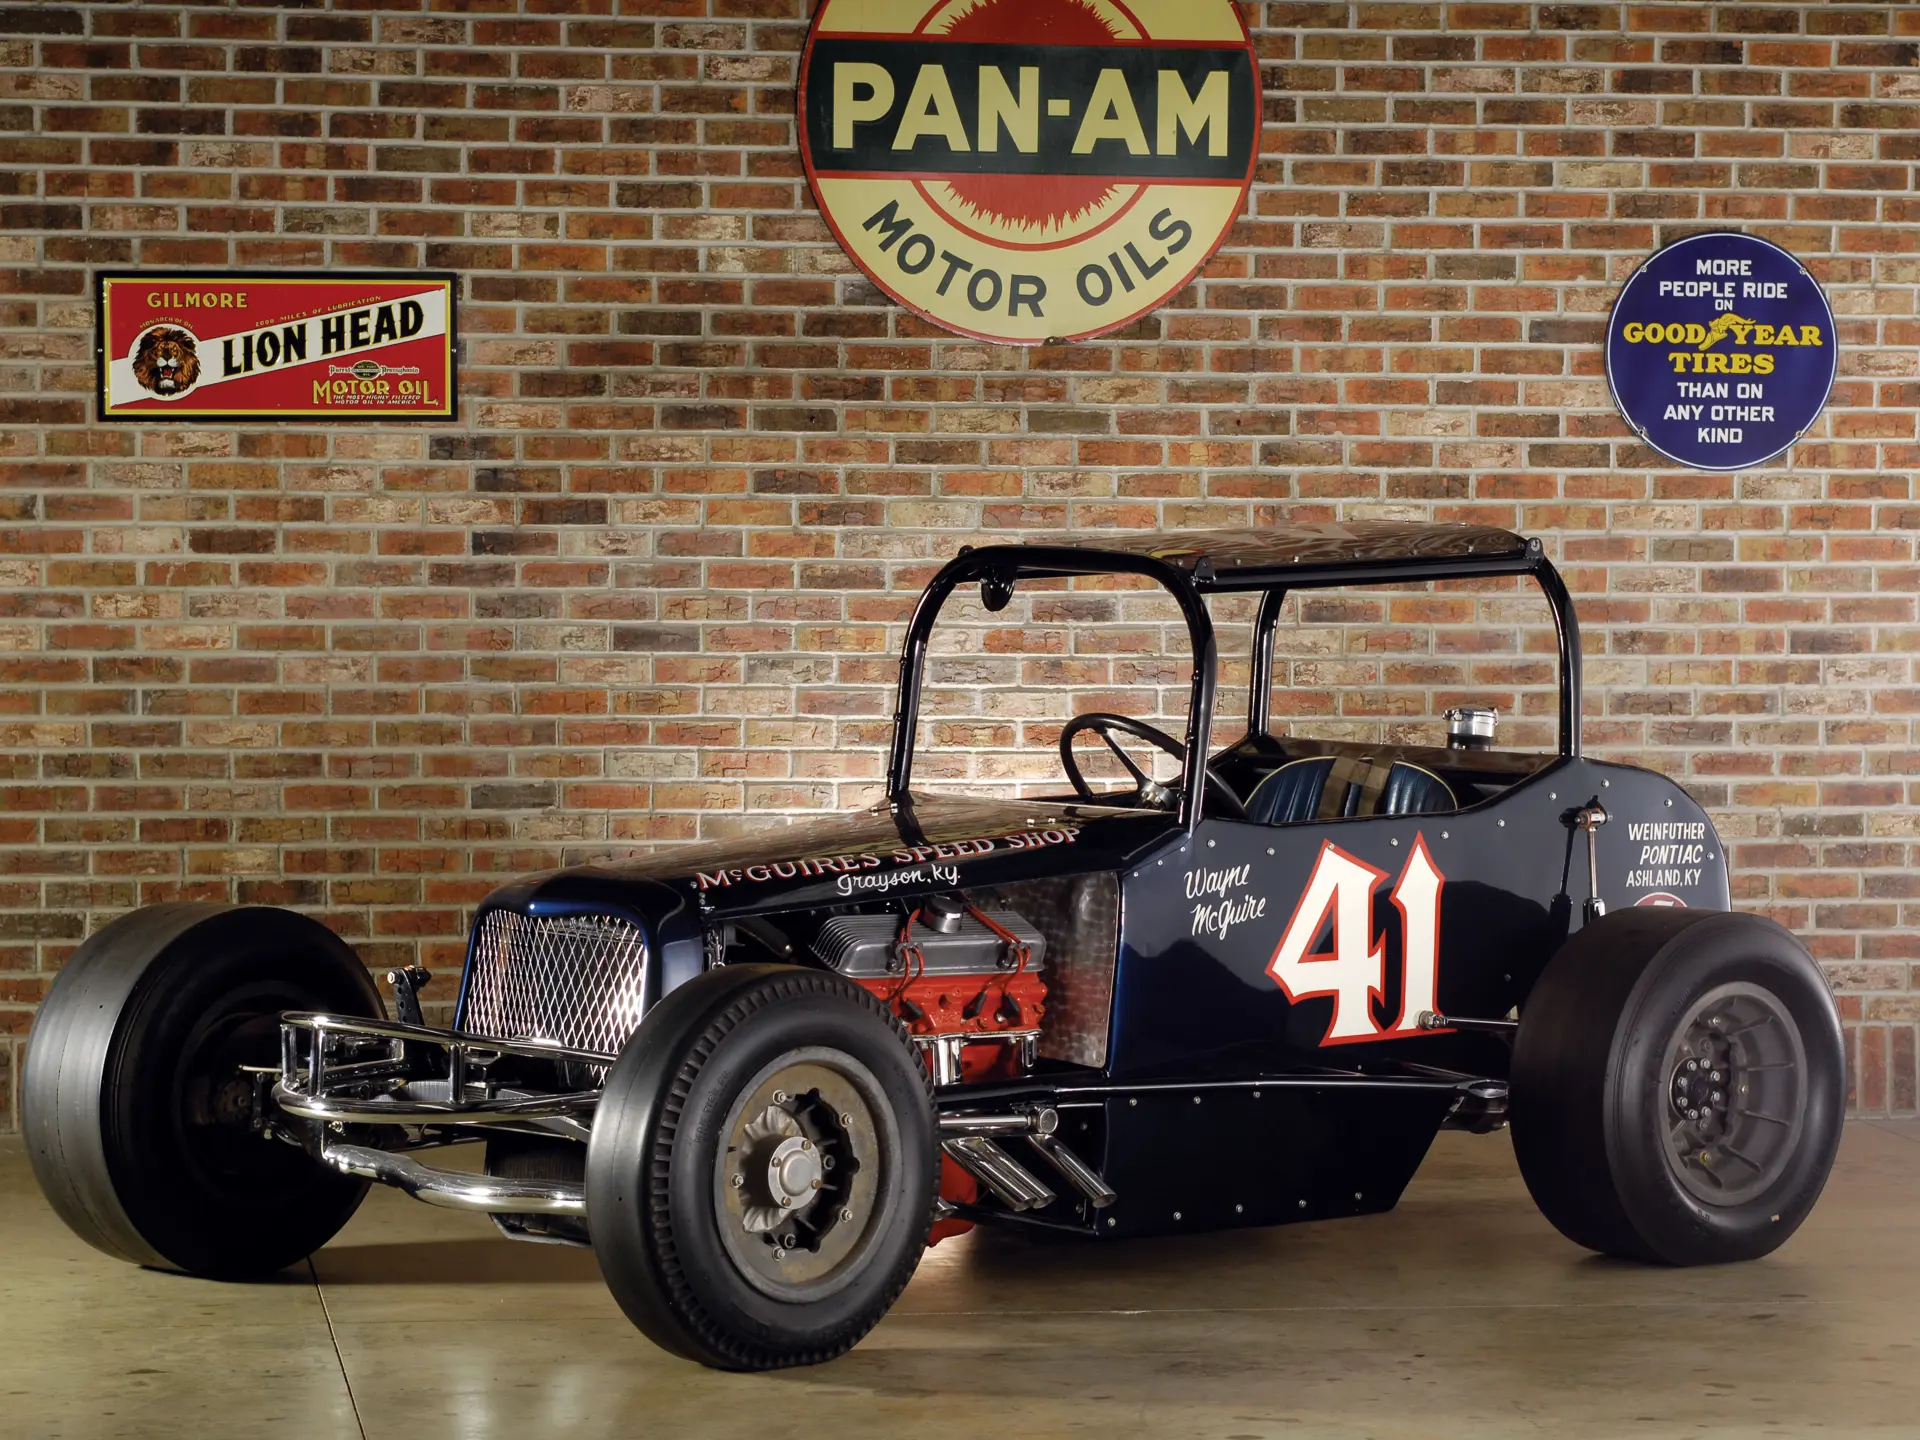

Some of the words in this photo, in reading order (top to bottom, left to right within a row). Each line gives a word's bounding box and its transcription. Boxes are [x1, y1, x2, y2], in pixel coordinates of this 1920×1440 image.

[832, 62, 1229, 157] PAN-AM
[862, 200, 1047, 317] MOTOR
[1075, 208, 1192, 307] OILS
[1696, 259, 1752, 276] MORE
[146, 292, 248, 308] GILMORE
[1659, 281, 1736, 298] PEOPLE
[1743, 282, 1788, 299] RIDE
[327, 295, 381, 312] LUBRICATION
[1715, 299, 1733, 311] ON
[222, 322, 307, 378] LION
[320, 299, 424, 356] HEAD
[1668, 352, 1775, 374] TIRES
[312, 380, 391, 405] MOTOR
[398, 380, 439, 406] OIL
[1677, 382, 1728, 399] THAN
[1737, 383, 1763, 399] ON
[1663, 404, 1704, 421] ANY
[1711, 405, 1775, 422] OTHER
[1697, 427, 1743, 443] KIND
[1628, 822, 1705, 841] WEINFUTHER
[892, 838, 996, 863] SPEED
[1004, 827, 1081, 850] SHOP
[1639, 844, 1704, 865] PONTIAC
[1184, 864, 1251, 899] Wayne
[1190, 896, 1266, 940] McGuire
[1264, 831, 1452, 1047] 41
